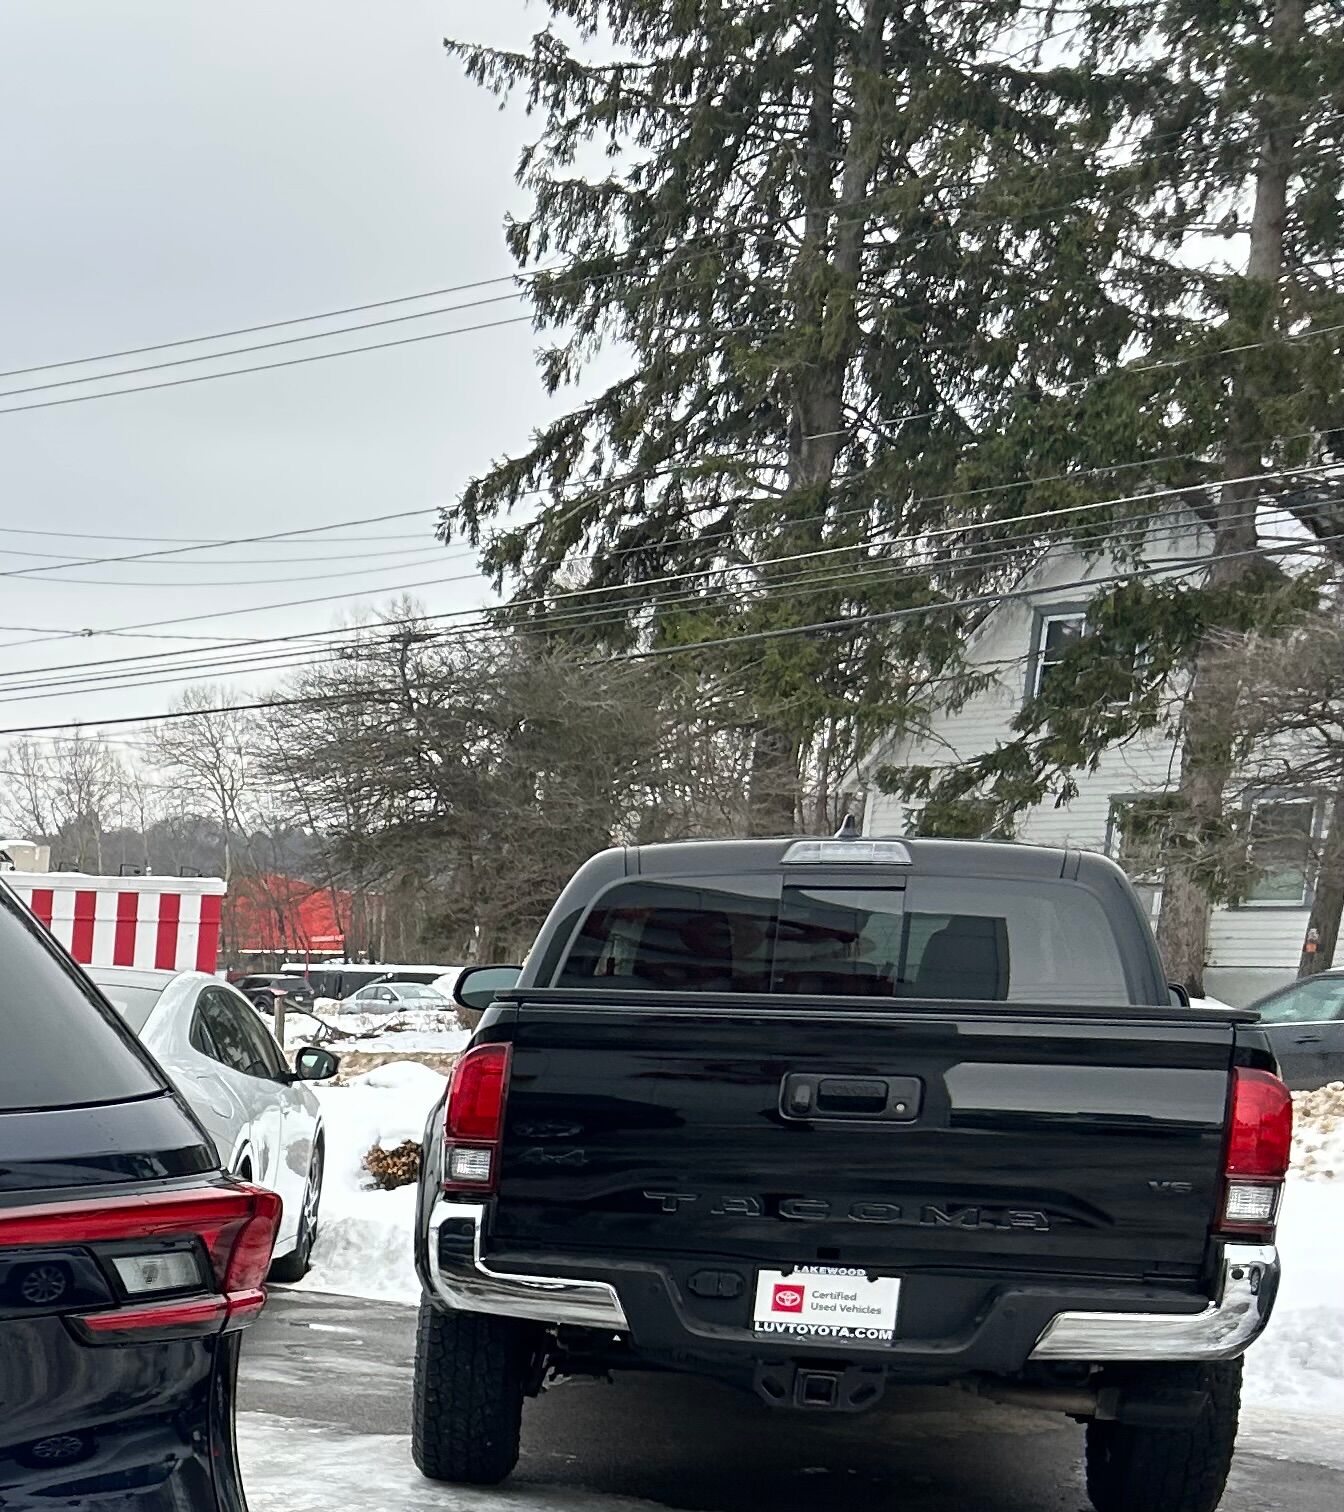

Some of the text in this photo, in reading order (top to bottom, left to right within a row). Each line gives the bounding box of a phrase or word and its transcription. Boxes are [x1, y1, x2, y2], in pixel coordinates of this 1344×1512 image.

[643, 1190, 1050, 1231] TACOMA
[794, 1264, 868, 1277] LAKEWOOD
[811, 1290, 858, 1302] Certified
[810, 1302, 883, 1315] Used Vehicles
[753, 1321, 893, 1341] LUVTOYOTA.COM
